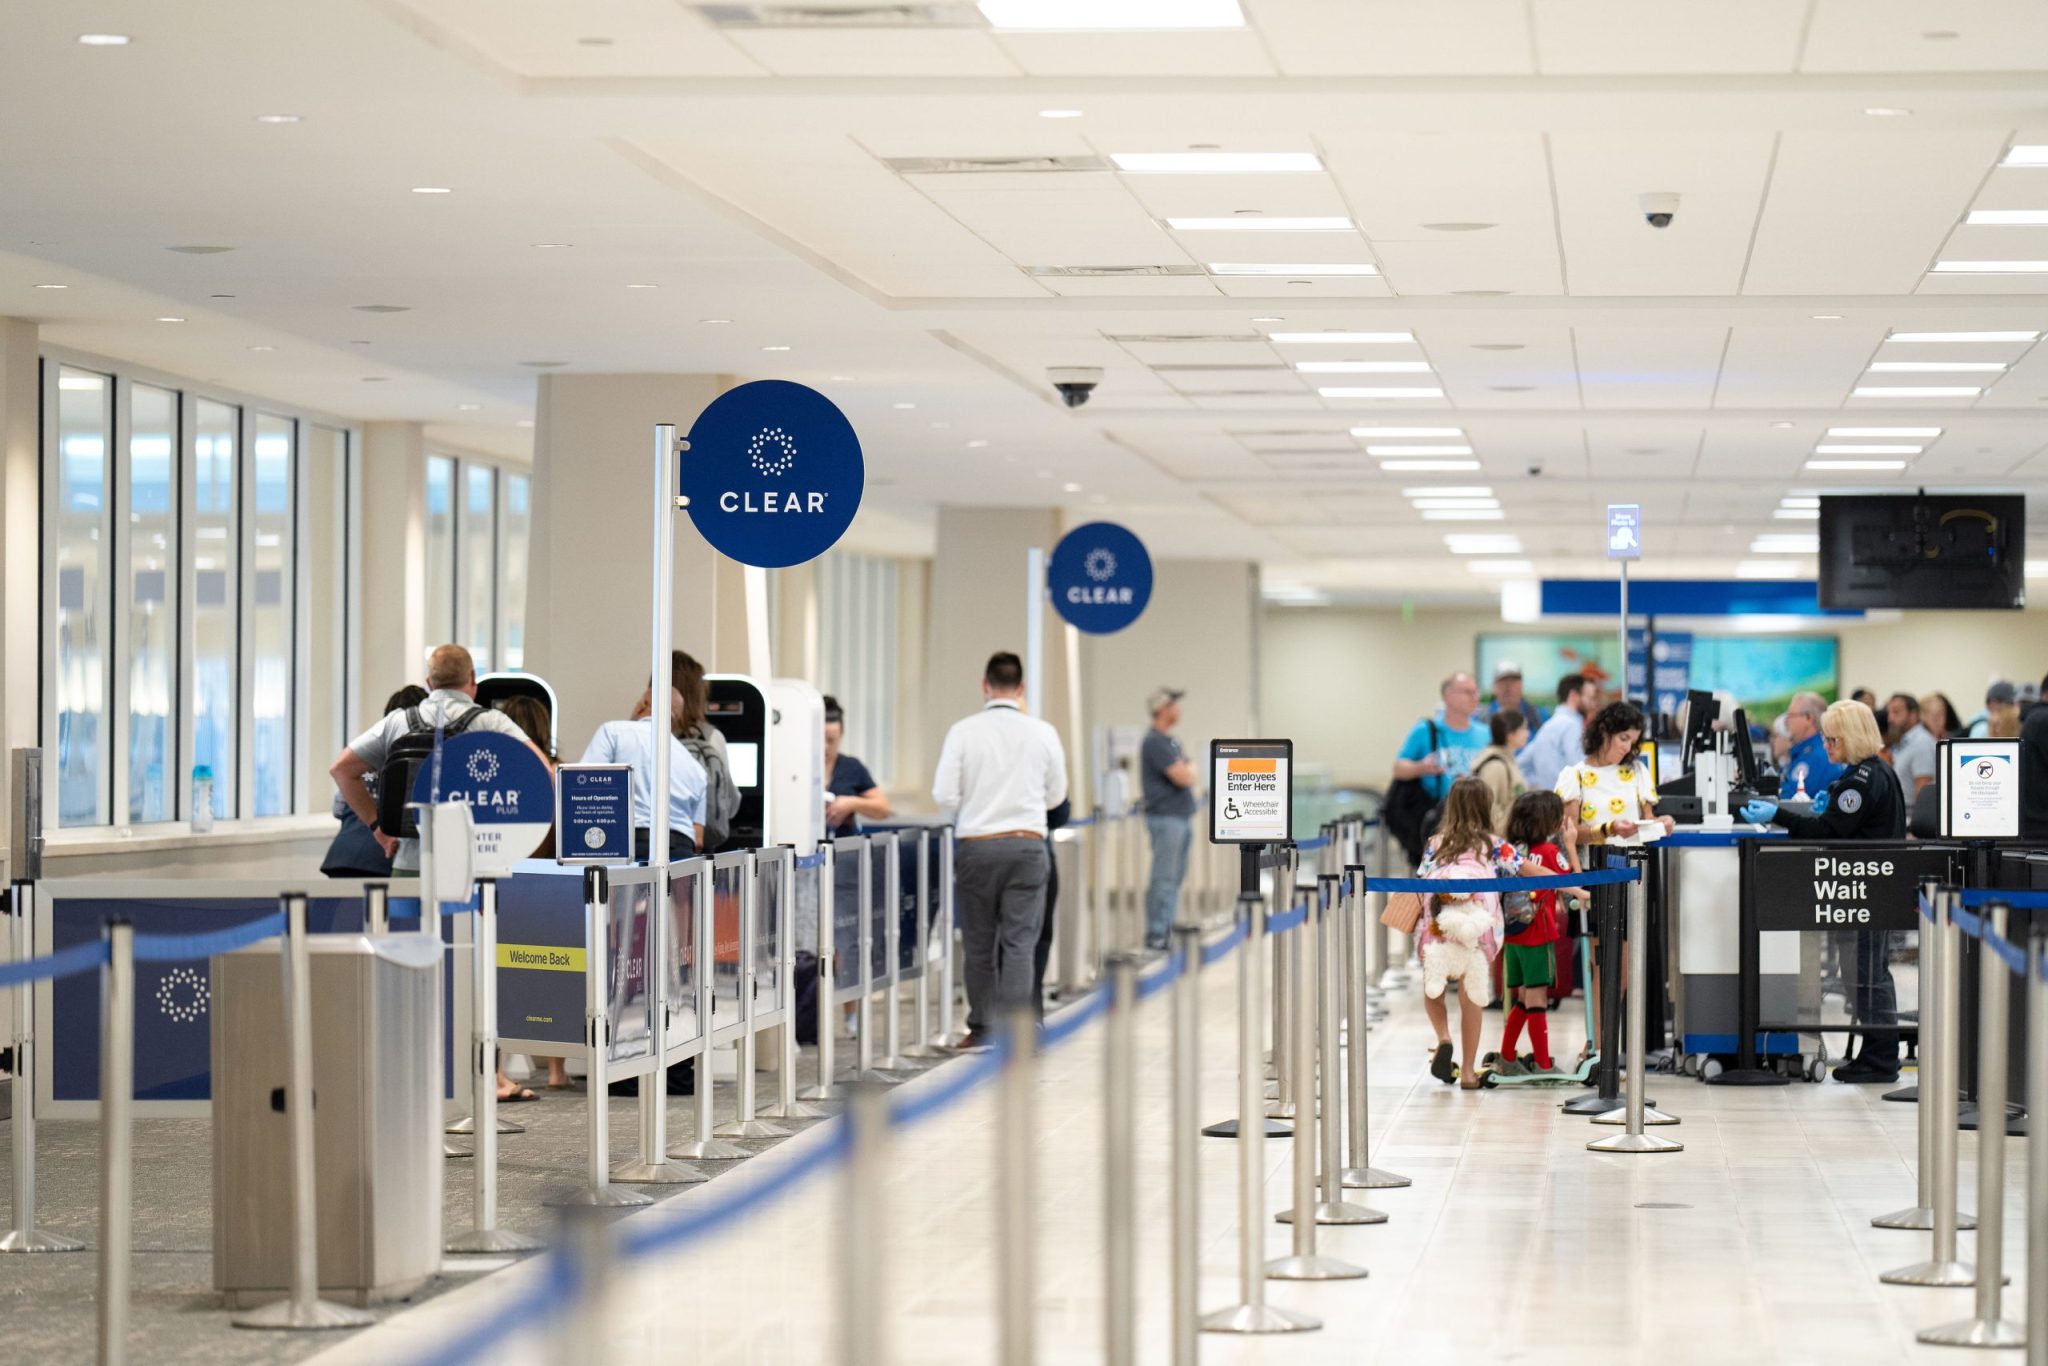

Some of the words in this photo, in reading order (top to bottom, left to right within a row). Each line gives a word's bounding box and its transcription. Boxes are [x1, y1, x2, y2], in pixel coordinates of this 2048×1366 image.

[720, 491, 826, 513] CLEAR
[1068, 586, 1132, 604] CLEAR
[1227, 772, 1276, 782] Employees
[1227, 782, 1251, 791] Enter
[1254, 782, 1276, 791] Here
[476, 832, 502, 842] NTER
[478, 844, 498, 853] ERE
[1814, 858, 1894, 876] Please
[1813, 880, 1867, 900] Wait
[1815, 905, 1871, 923] Here
[510, 950, 547, 964] Welcome
[549, 952, 570, 966] Back
[626, 957, 643, 979] CLEAR
[526, 1015, 553, 1023] clearme.com
